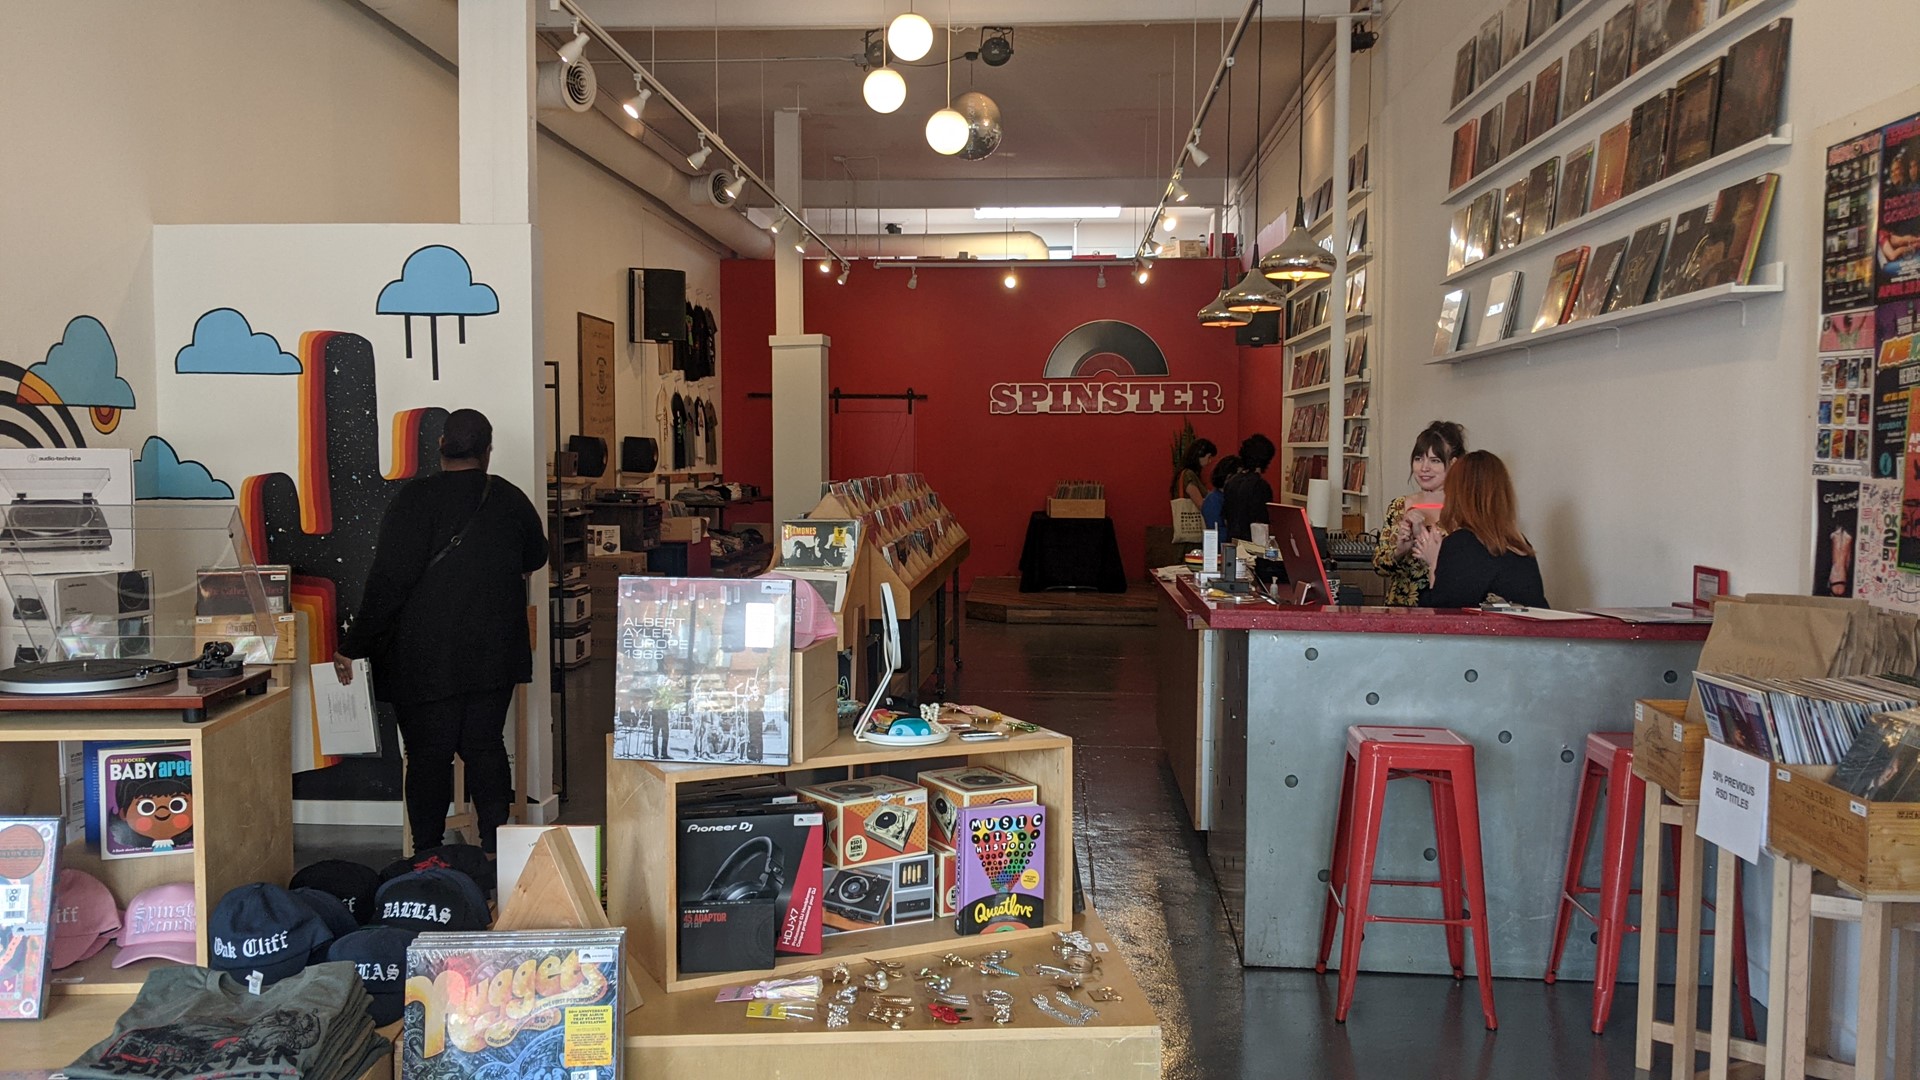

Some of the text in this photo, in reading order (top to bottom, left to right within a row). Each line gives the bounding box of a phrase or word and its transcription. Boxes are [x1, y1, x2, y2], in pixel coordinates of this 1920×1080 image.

[991, 382, 1223, 414] SPINSTER
[784, 525, 816, 540] RAMONES
[623, 617, 685, 627] ALBERT
[623, 628, 672, 639] AYLER
[623, 638, 688, 650] EUROPE
[624, 649, 664, 660] 1966
[110, 762, 157, 781] BABY
[1724, 775, 1755, 797] PREVIOUS
[1715, 787, 1749, 810] RSD TITLES
[687, 823, 737, 833] Pioneer
[971, 814, 1041, 830] MUSIC
[995, 832, 1013, 841] IS
[976, 843, 1035, 854] HISTORY
[382, 901, 452, 924] DALLAS
[974, 893, 1033, 923] Questlove
[683, 912, 727, 923] 45 ADAPTOR
[782, 907, 799, 945] HDJ-X7
[214, 931, 289, 959] Oak Cliff
[355, 963, 400, 981] LAS
